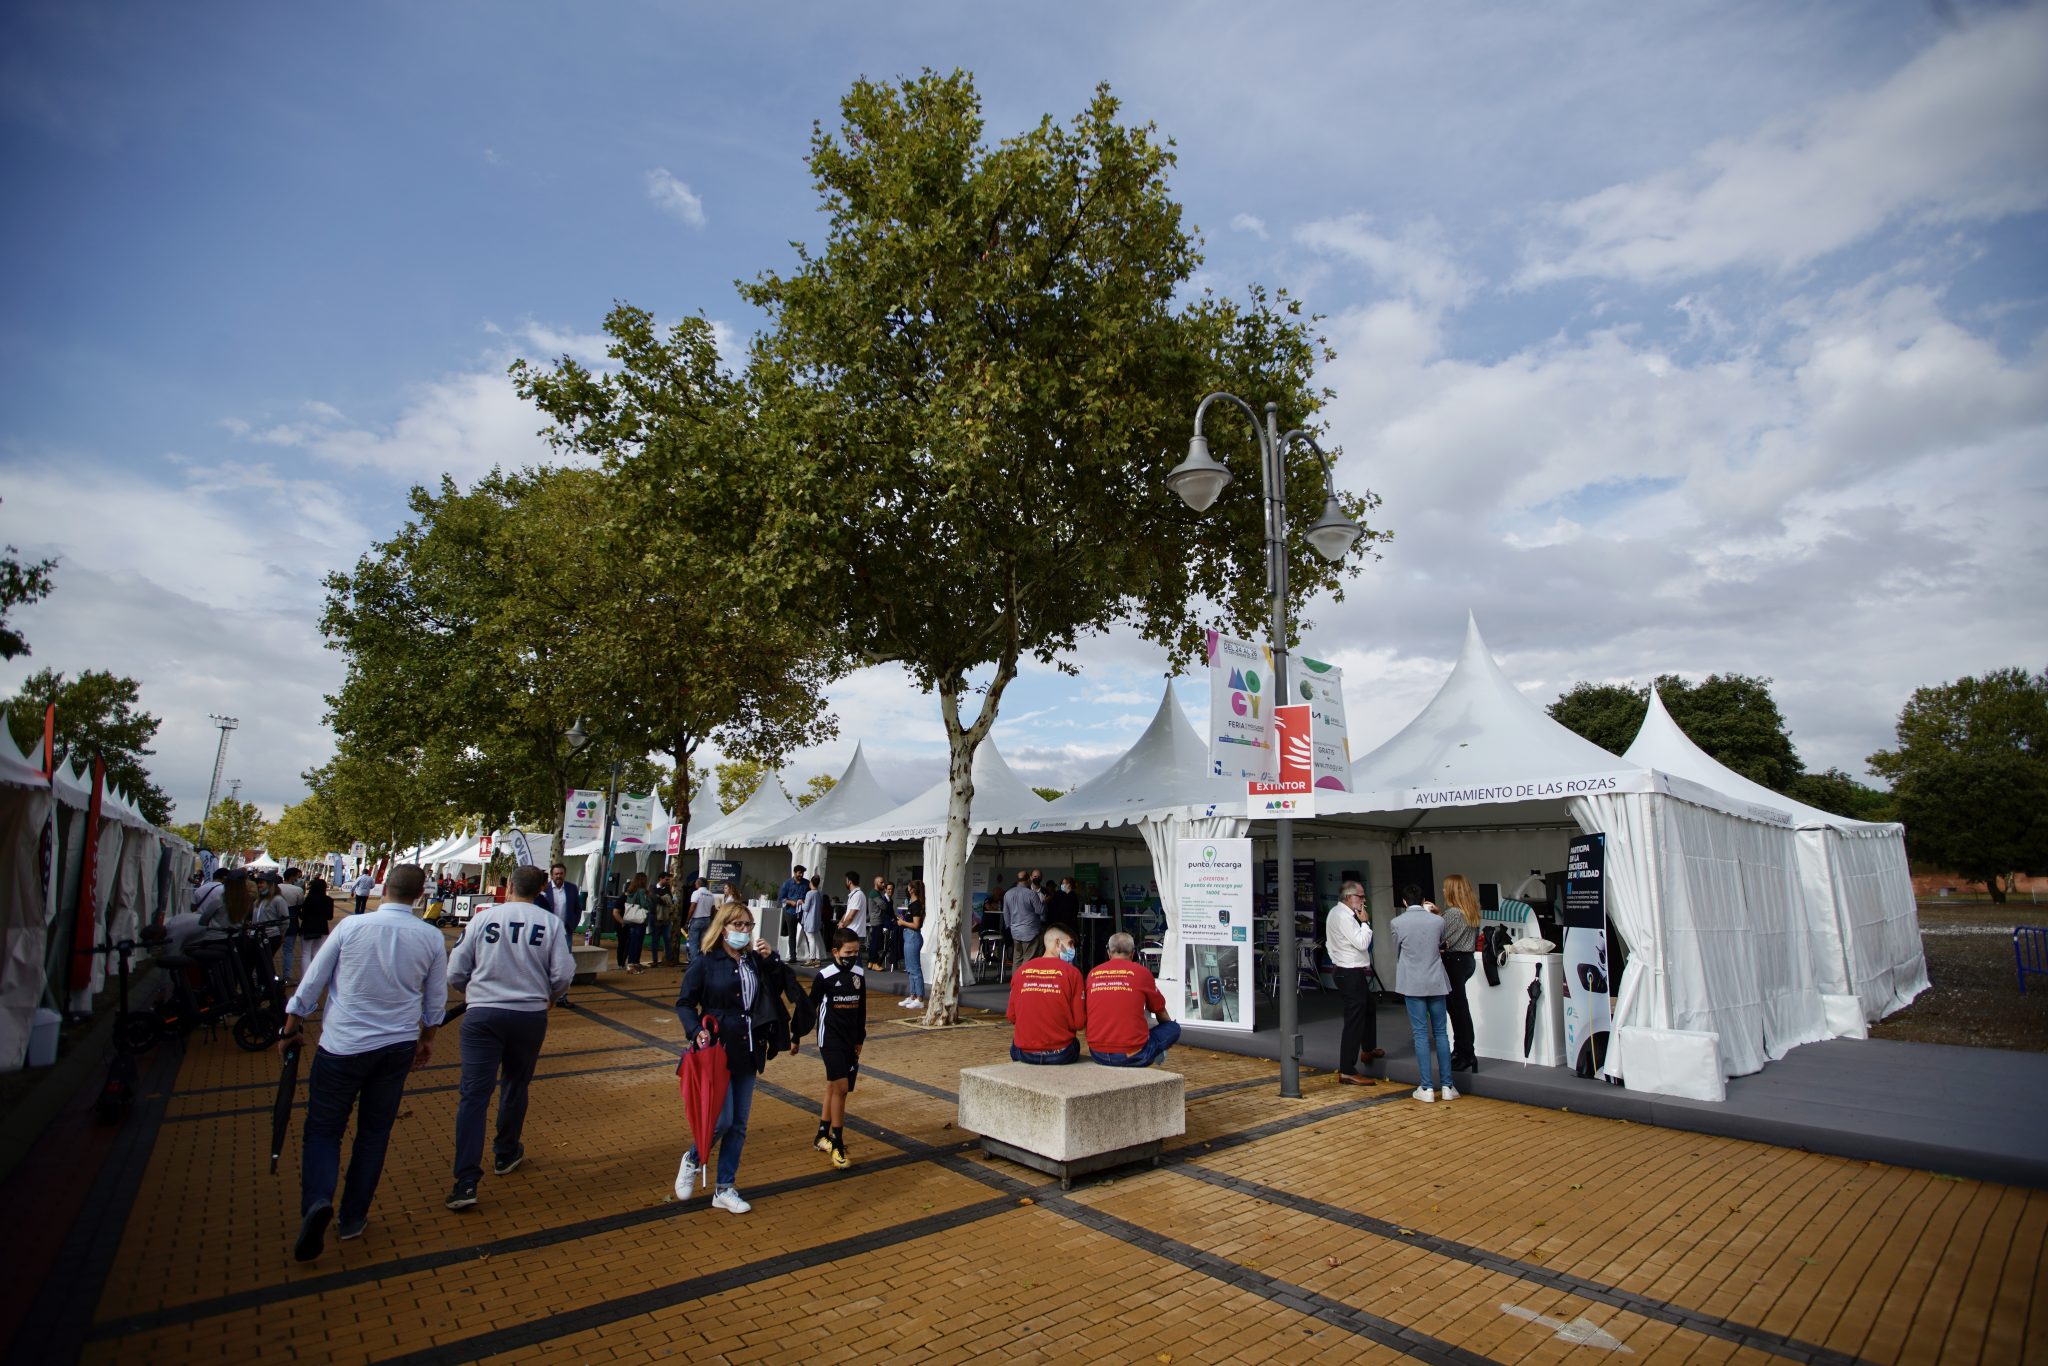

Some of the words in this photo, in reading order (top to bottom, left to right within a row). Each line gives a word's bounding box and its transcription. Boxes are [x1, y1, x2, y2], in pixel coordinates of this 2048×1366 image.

[1228, 721, 1244, 729] FERIA
[1256, 781, 1306, 791] EXTINTOR
[1416, 786, 1512, 804] AYUNTAMIENTO
[1516, 784, 1534, 797] DE
[1538, 782, 1563, 795] LAS
[1567, 777, 1617, 792] ROZAS
[1570, 845, 1590, 854] PARTICIPA
[1569, 862, 1588, 871] ENCUESTA
[485, 922, 546, 946] STE
